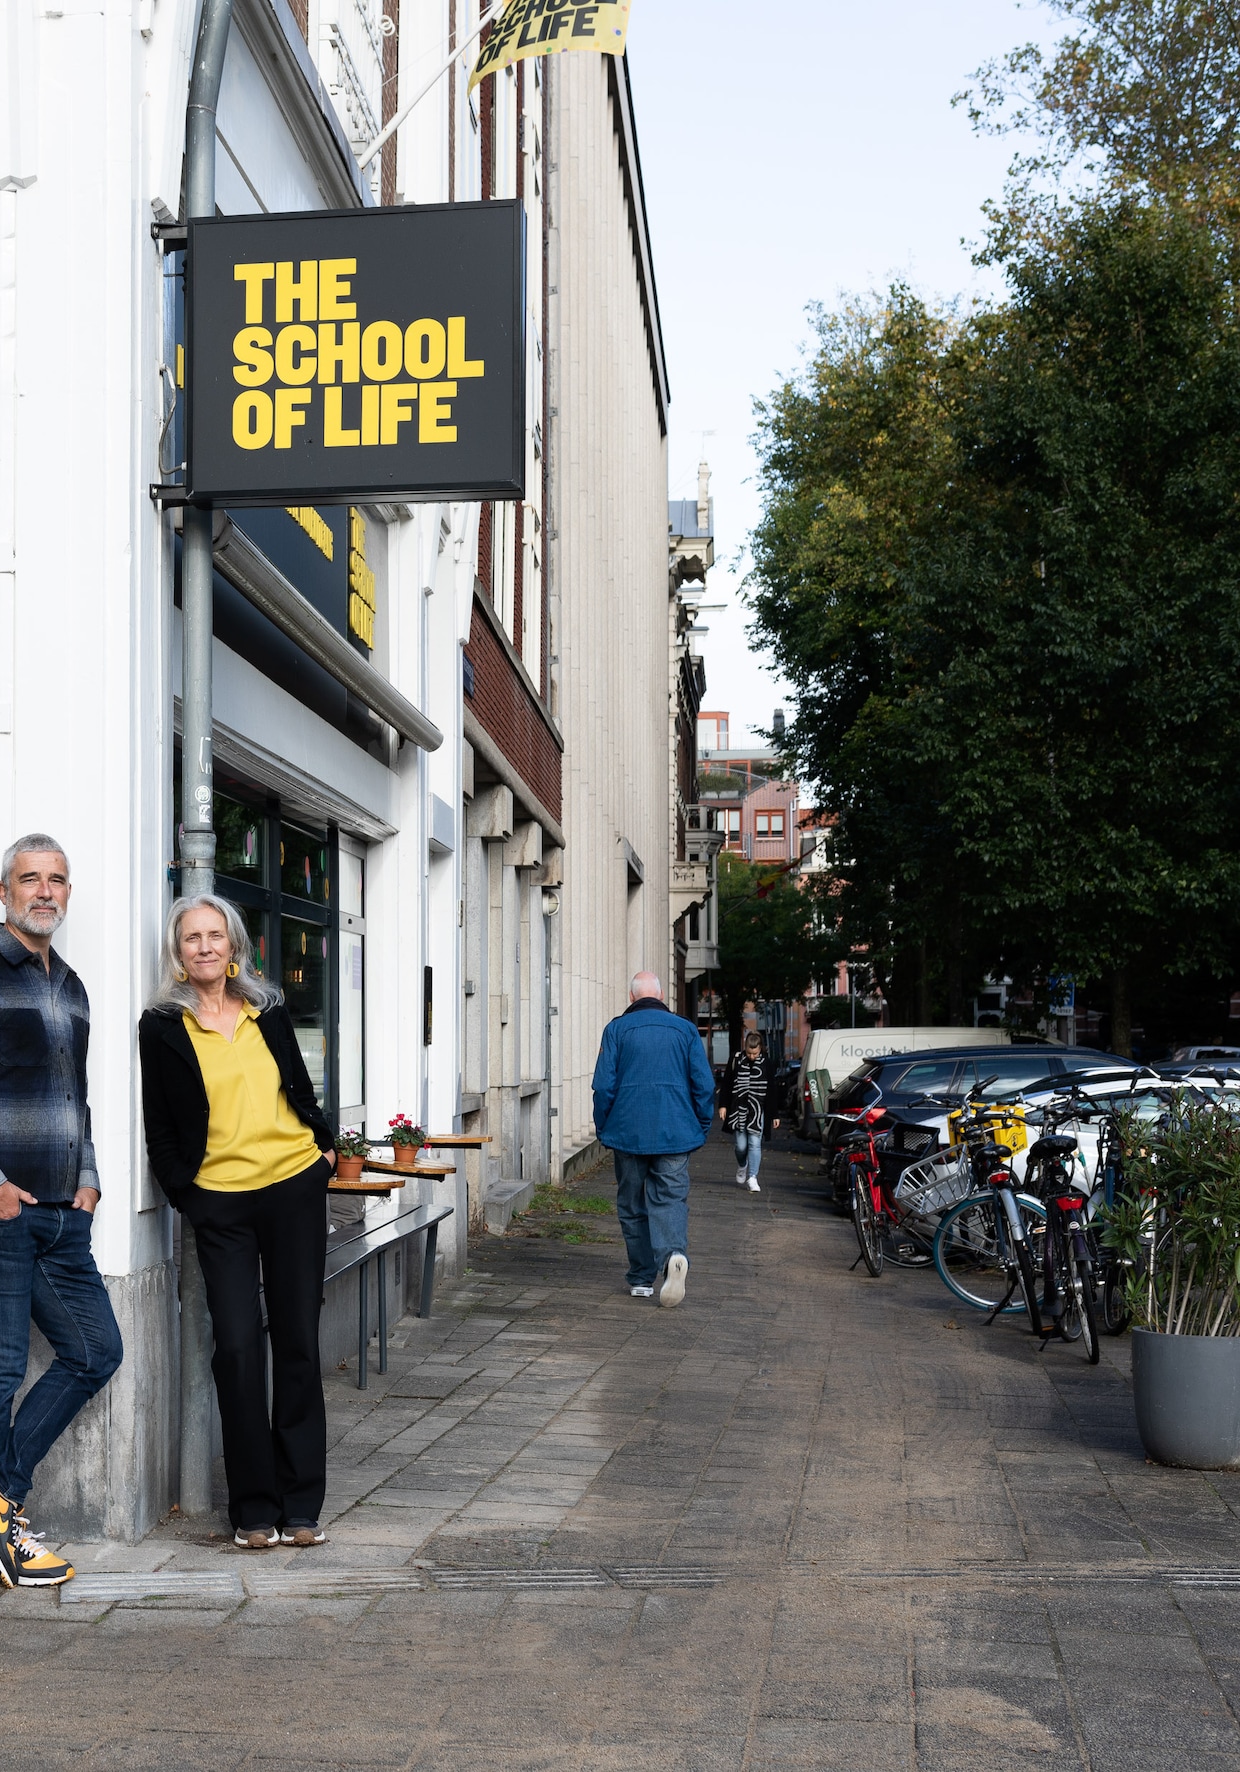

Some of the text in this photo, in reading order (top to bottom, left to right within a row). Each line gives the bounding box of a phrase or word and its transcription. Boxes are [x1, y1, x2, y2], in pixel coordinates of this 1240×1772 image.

[476, 6, 599, 73] OF LIFE
[234, 258, 357, 324] THE
[232, 316, 485, 387] SCHOOL
[232, 381, 458, 450] OF LIFE
